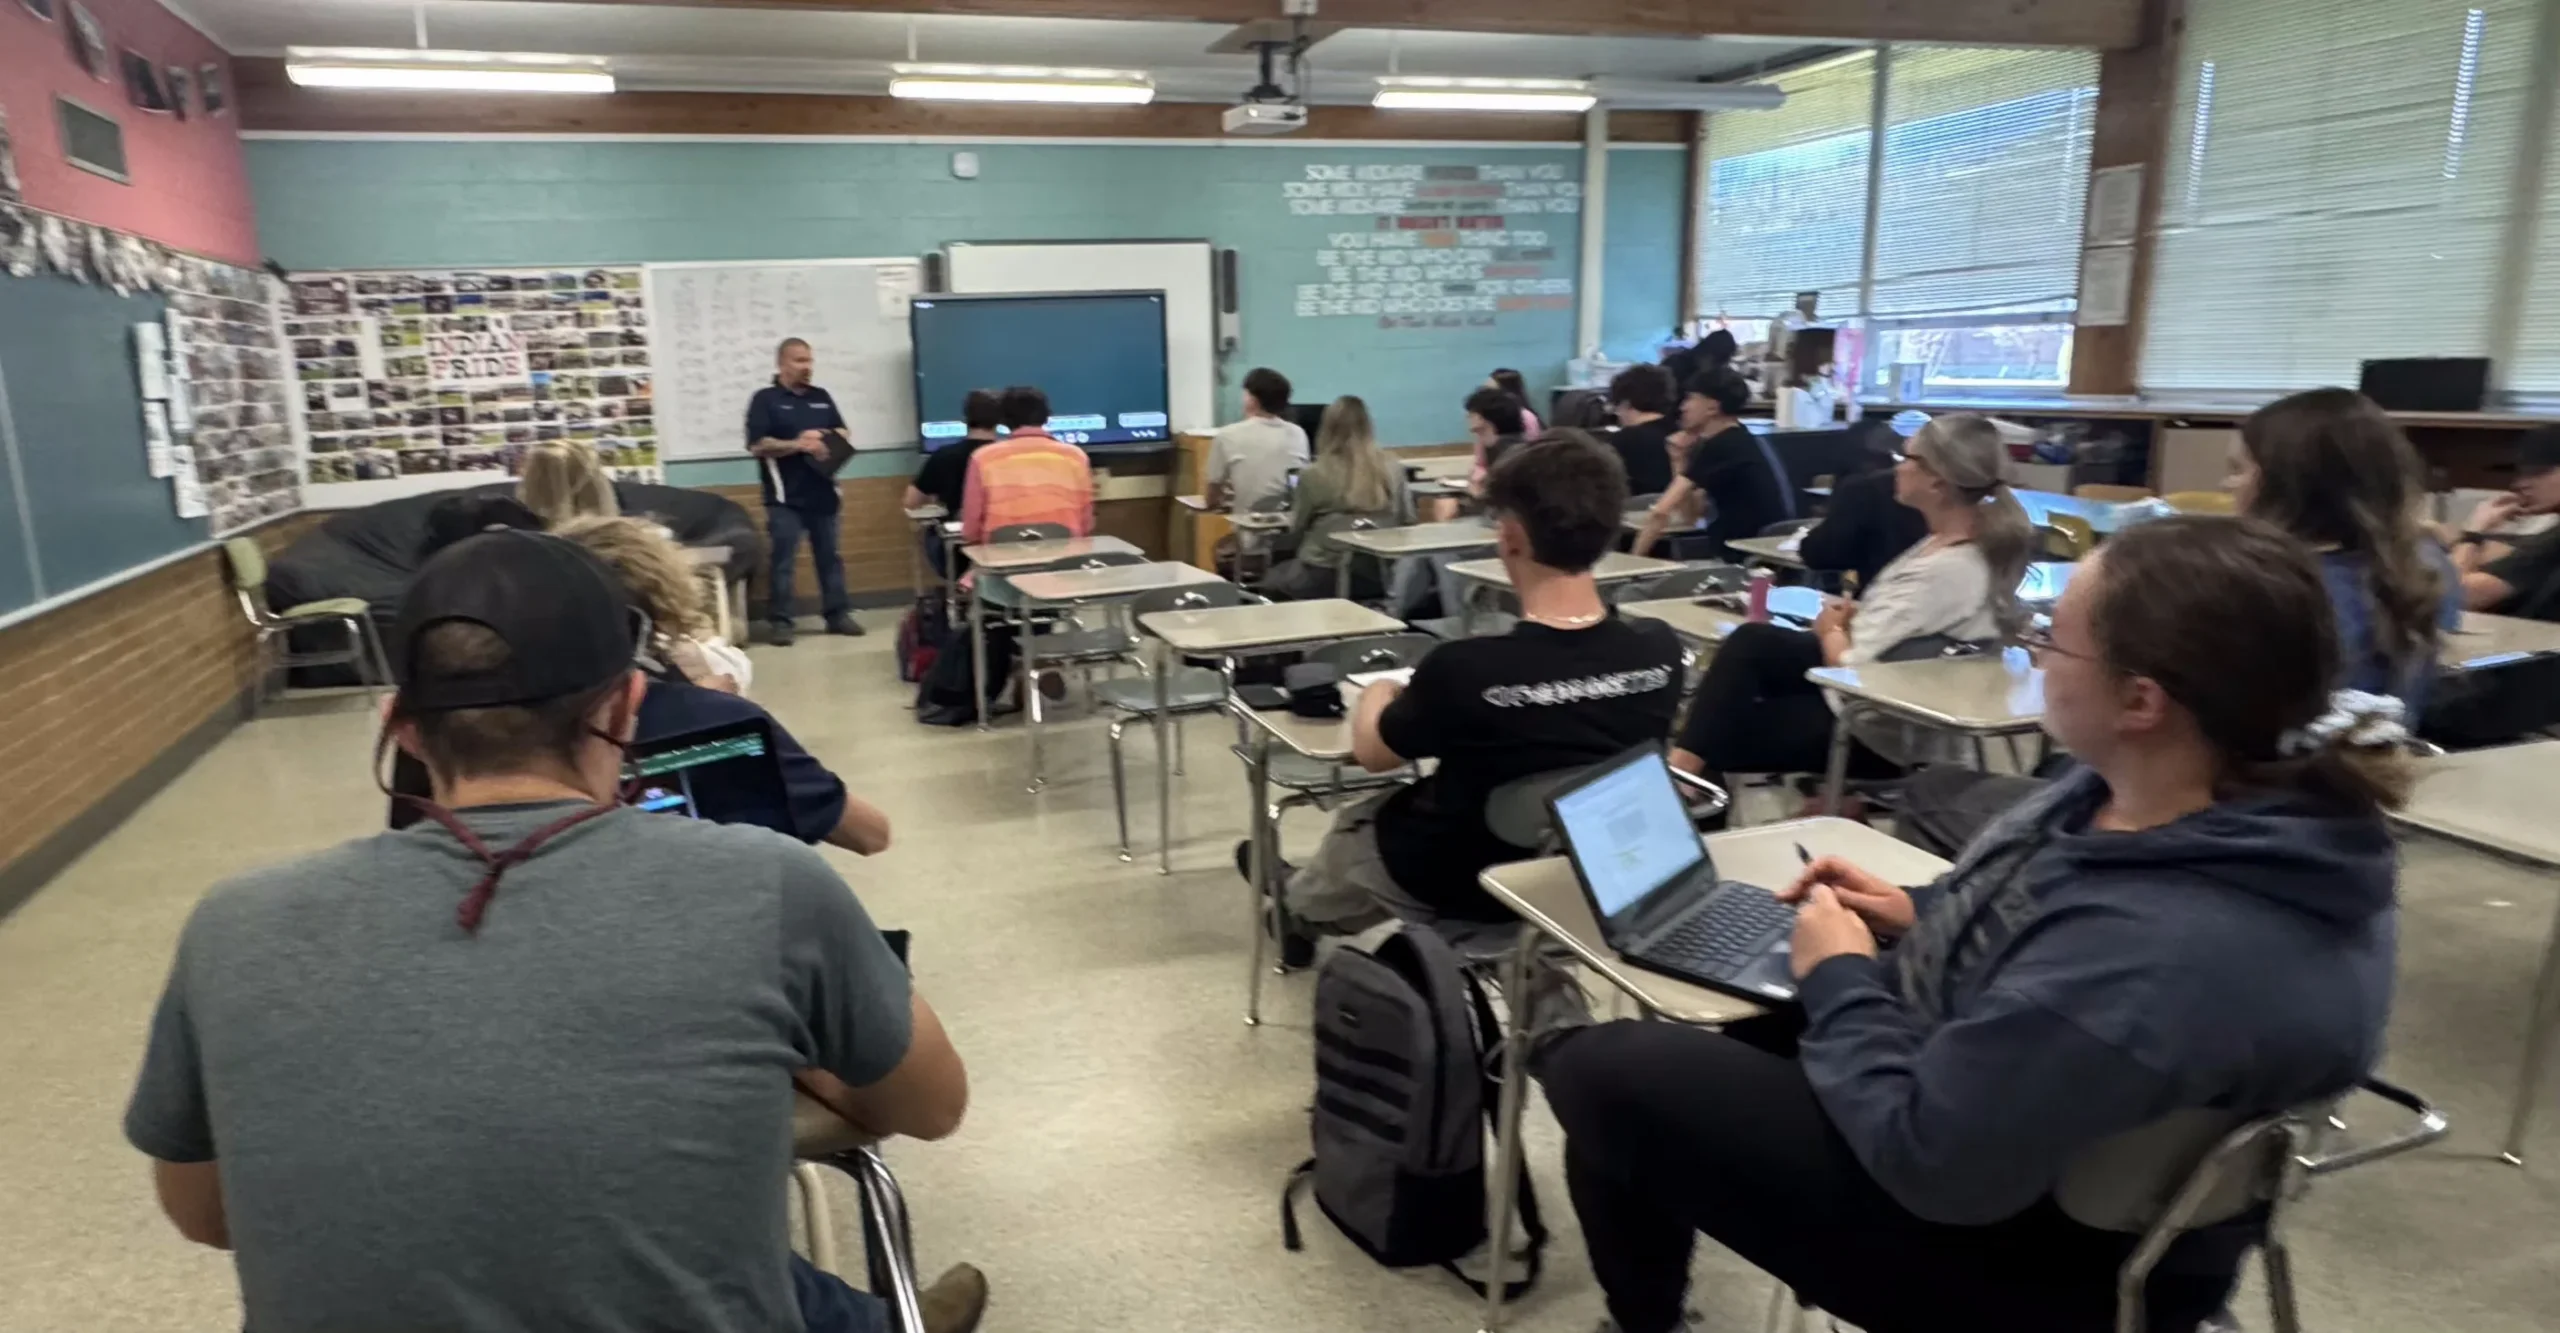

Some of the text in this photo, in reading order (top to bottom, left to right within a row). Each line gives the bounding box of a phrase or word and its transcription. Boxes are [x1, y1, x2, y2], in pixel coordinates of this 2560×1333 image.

[1305, 164, 1351, 180] SOME
[1328, 232, 1367, 248] YOU
[426, 327, 528, 356] INDIAN
[432, 356, 520, 379] PRIDE
